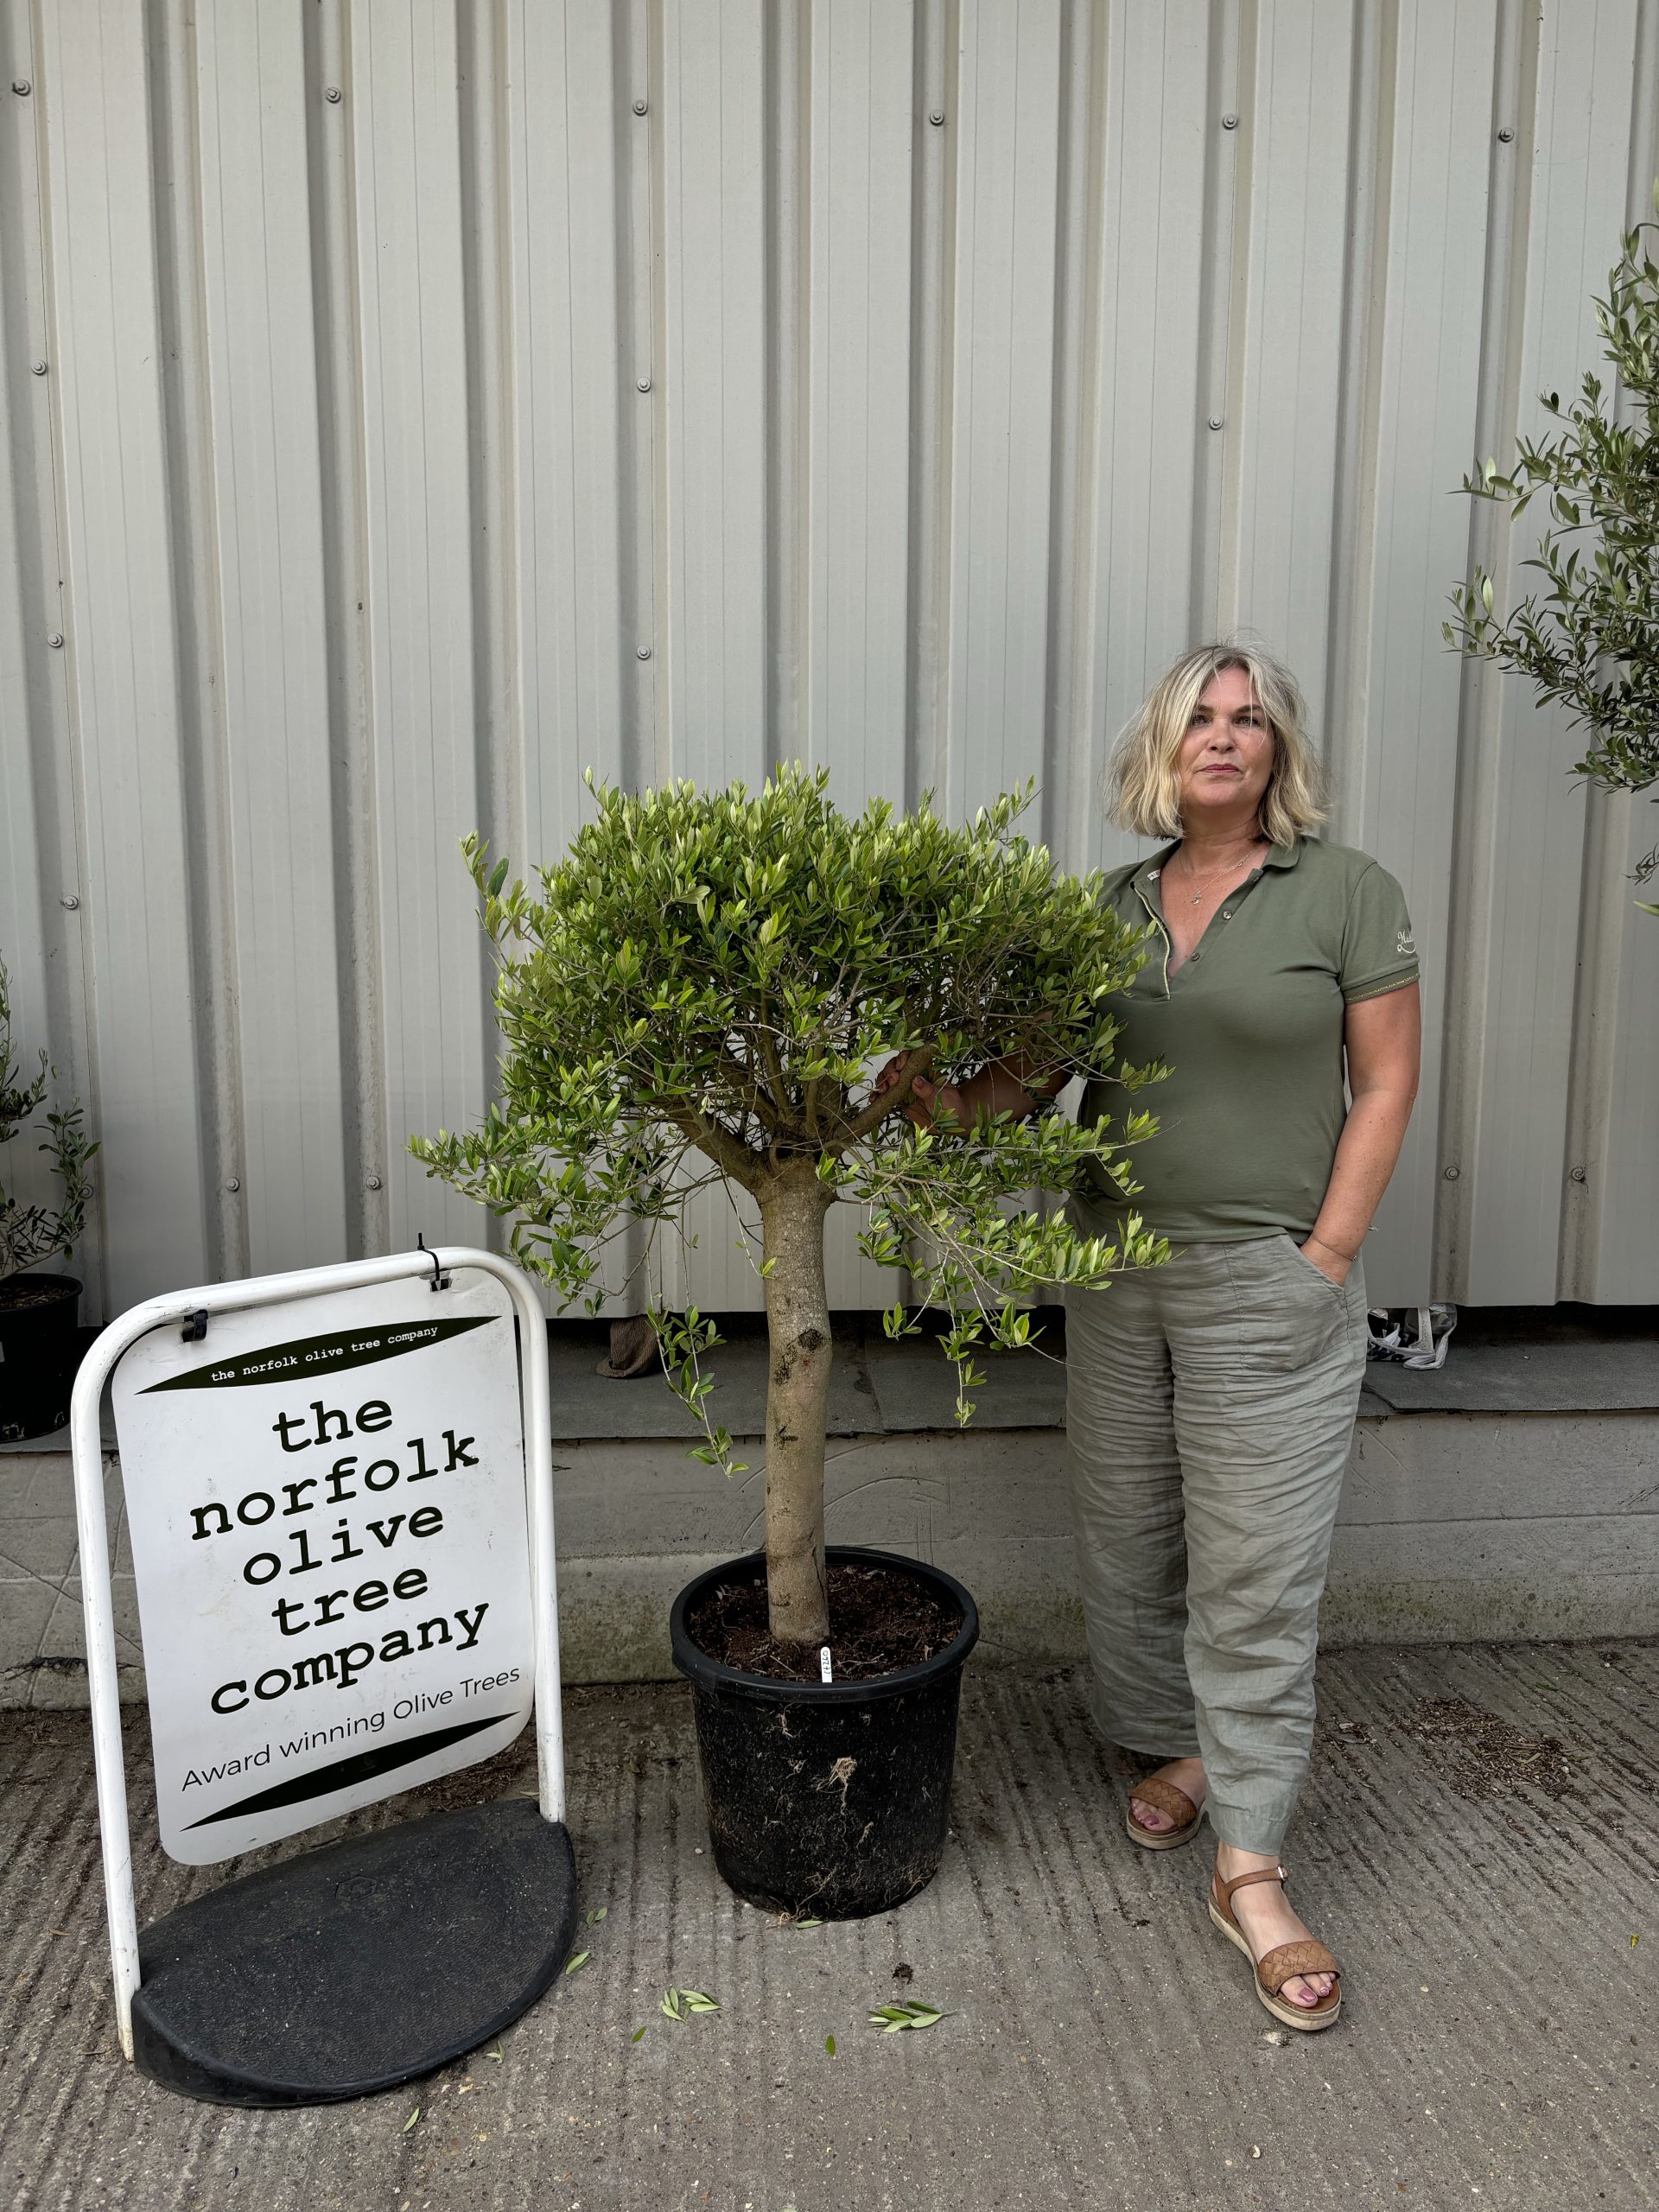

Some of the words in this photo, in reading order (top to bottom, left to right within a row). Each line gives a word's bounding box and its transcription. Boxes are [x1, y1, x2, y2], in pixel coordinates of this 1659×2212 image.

[211, 1371, 236, 1382] the
[243, 1356, 298, 1376] norfolk
[305, 1347, 344, 1362] olive
[351, 1338, 381, 1352] tree
[387, 1326, 439, 1344] company
[272, 1401, 393, 1452] the
[190, 1430, 480, 1541] norfolk
[244, 1507, 444, 1586] olive
[271, 1568, 429, 1637] tree
[212, 1603, 490, 1714] company
[181, 1744, 270, 1792] Award
[278, 1712, 385, 1758] winning
[393, 1688, 454, 1720] Olive
[460, 1666, 521, 1698] Trees
